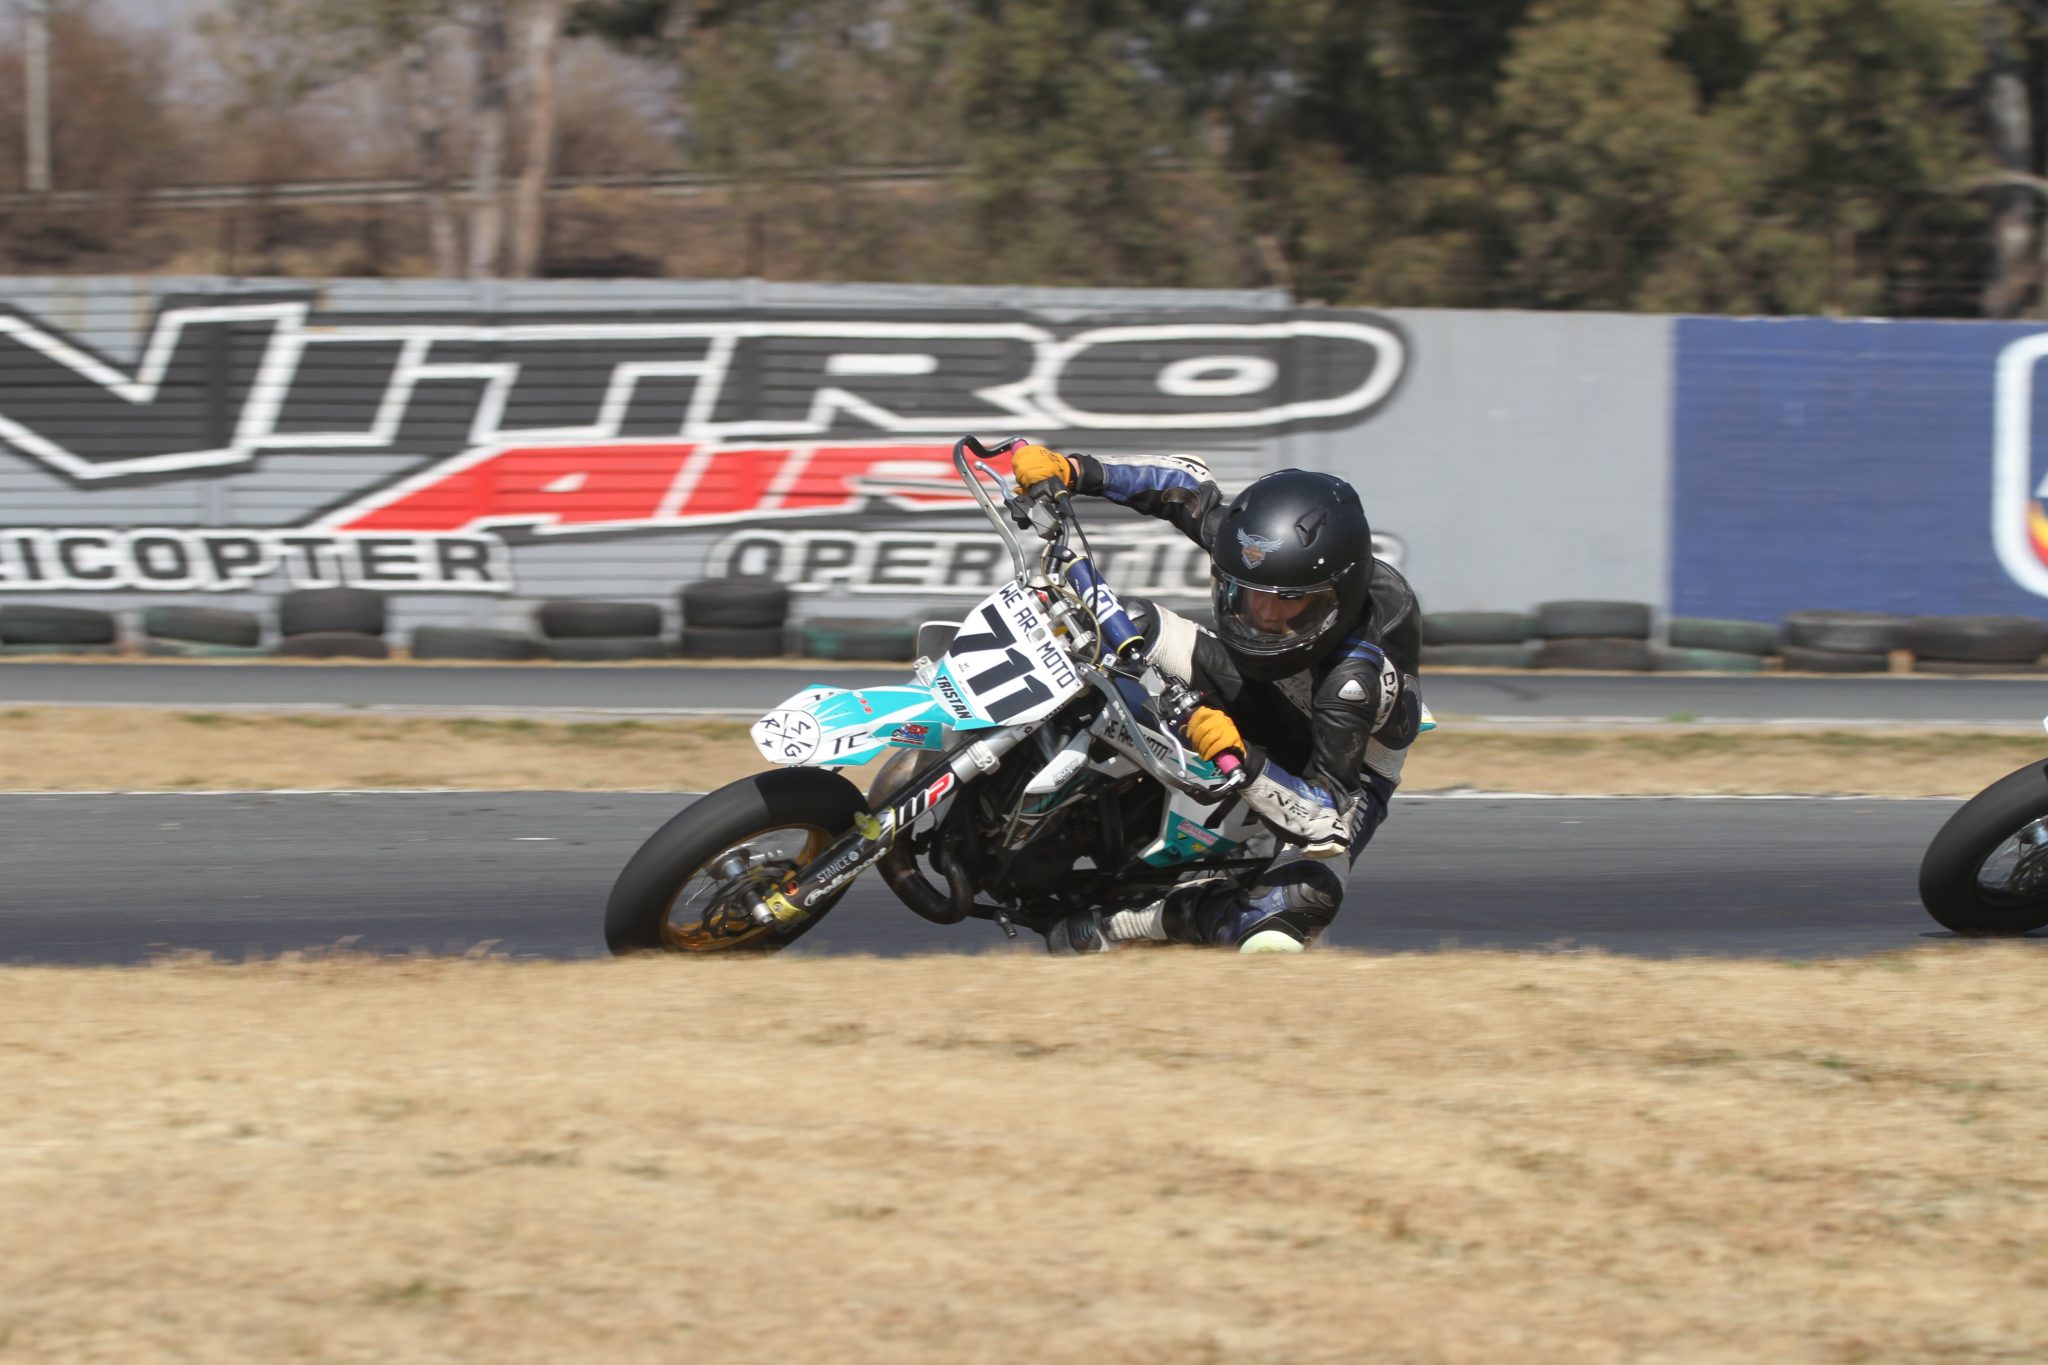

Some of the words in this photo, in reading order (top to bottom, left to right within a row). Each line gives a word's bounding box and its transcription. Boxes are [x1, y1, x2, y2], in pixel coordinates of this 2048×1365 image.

[0, 532, 502, 584] ICOPTER
[999, 582, 1023, 609] WE
[1036, 640, 1076, 689] MOTO
[949, 603, 1055, 724] 711
[936, 675, 973, 719] TRISTAN
[816, 854, 851, 884] STANCE
